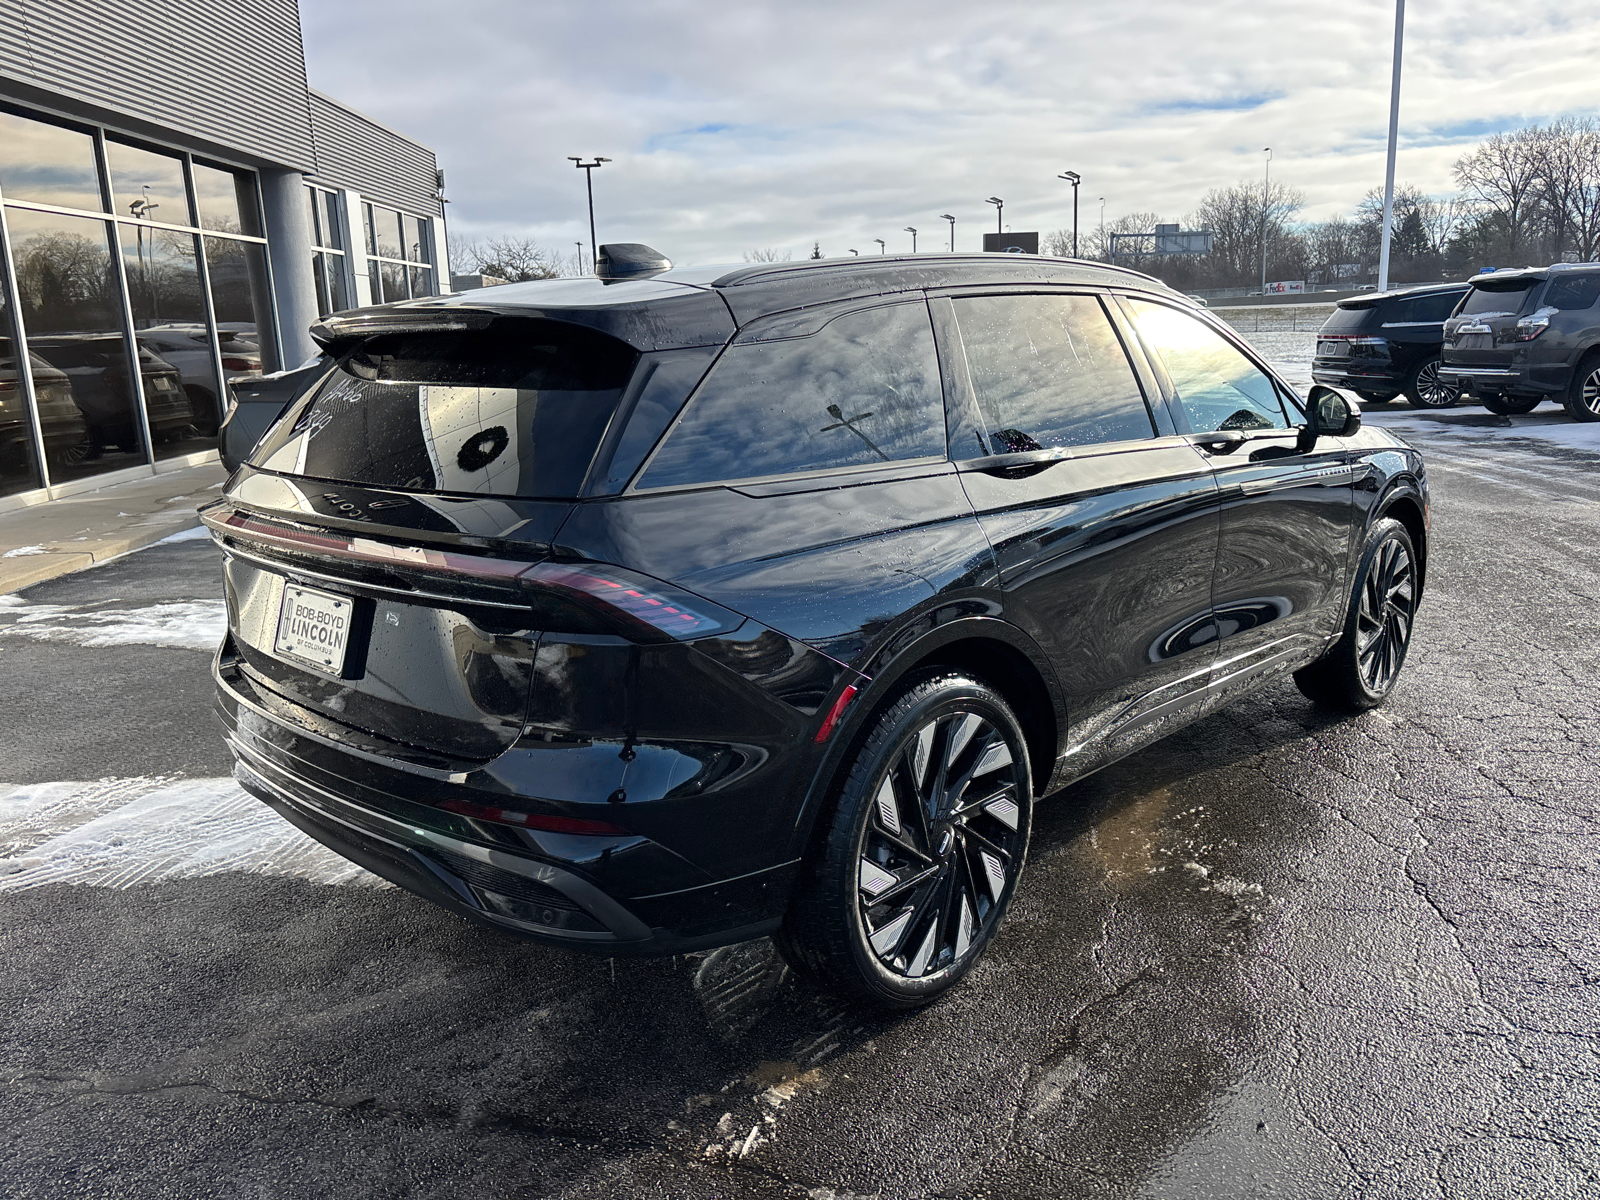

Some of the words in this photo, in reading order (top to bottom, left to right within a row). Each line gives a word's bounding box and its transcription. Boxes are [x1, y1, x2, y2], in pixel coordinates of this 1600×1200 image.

[1269, 283, 1285, 293] FedEx
[295, 604, 344, 629] BOB-BOYD
[291, 617, 345, 650] LINCOLN
